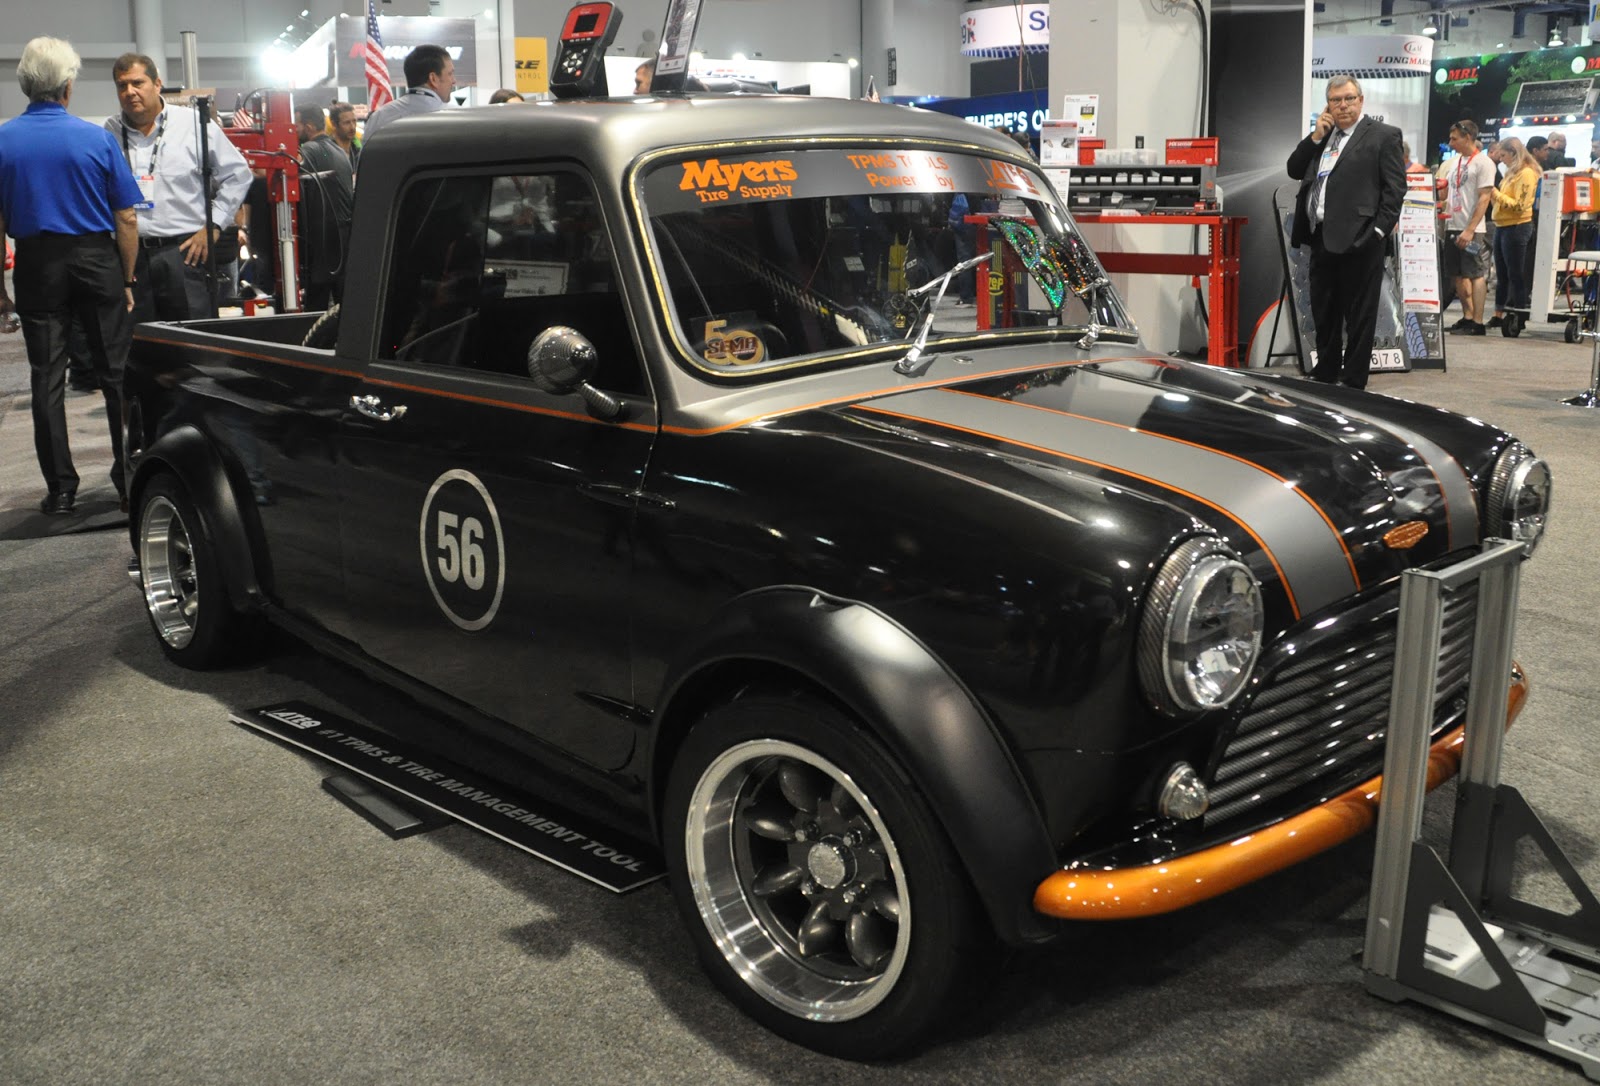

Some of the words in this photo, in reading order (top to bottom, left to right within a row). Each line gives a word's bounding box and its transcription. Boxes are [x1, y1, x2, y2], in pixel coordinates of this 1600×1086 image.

[1448, 67, 1478, 80] MRL
[679, 158, 799, 192] Myers
[847, 154, 897, 170] TPMS
[897, 155, 949, 171] TLS
[696, 189, 729, 203] Tire
[740, 183, 793, 199] Supply
[866, 172, 918, 188] Power
[937, 174, 955, 191] by
[703, 319, 765, 366] 50
[437, 510, 486, 592] 56
[317, 729, 345, 739] #1
[337, 736, 390, 758] TPMS
[380, 755, 404, 765] &
[398, 760, 445, 782] TIRE
[434, 778, 588, 844] MANAGEMENT
[580, 840, 646, 873] TOOL
